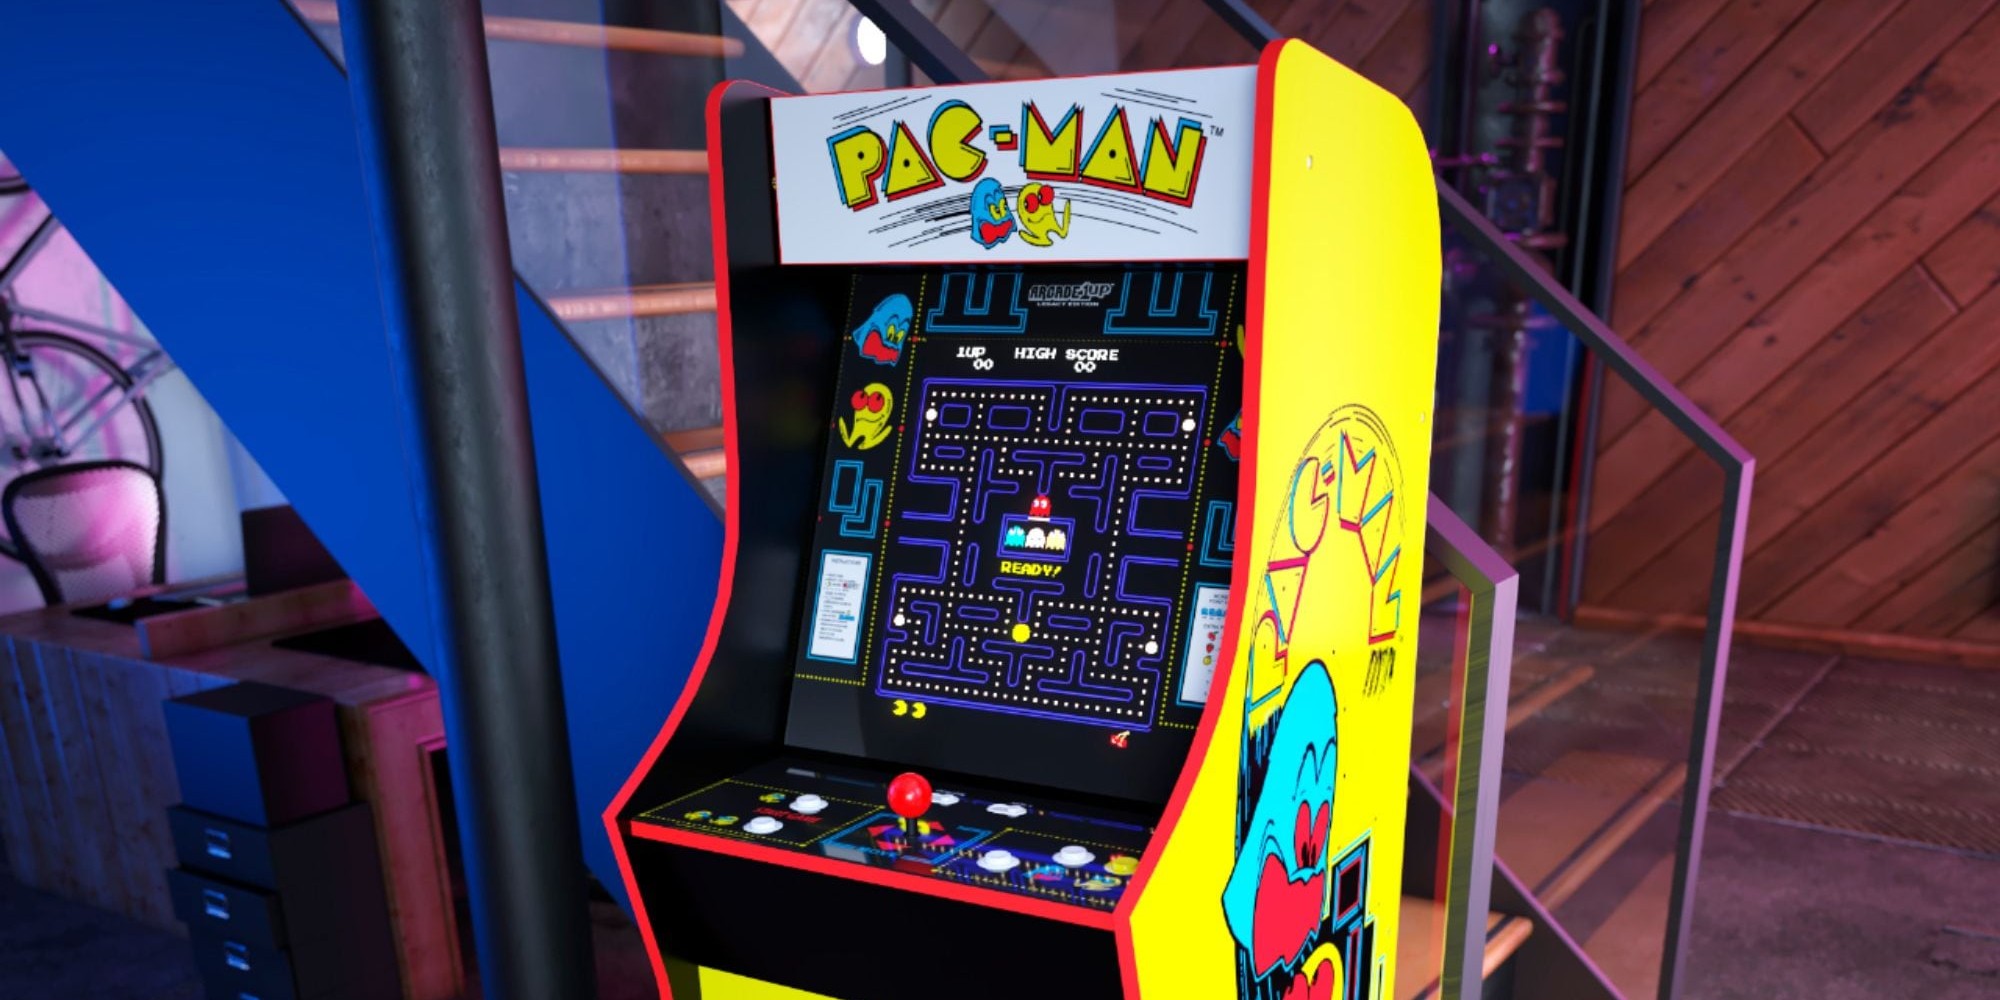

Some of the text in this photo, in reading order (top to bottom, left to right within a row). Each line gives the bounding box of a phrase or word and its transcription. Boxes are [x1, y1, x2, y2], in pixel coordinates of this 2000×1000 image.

[827, 99, 1207, 212] PAC-MAN
[956, 346, 986, 358] 1UP
[1014, 347, 1119, 361] HIGH SCORE
[973, 358, 994, 371] 00
[1073, 360, 1097, 373] 00
[1001, 560, 1062, 578] READY!
